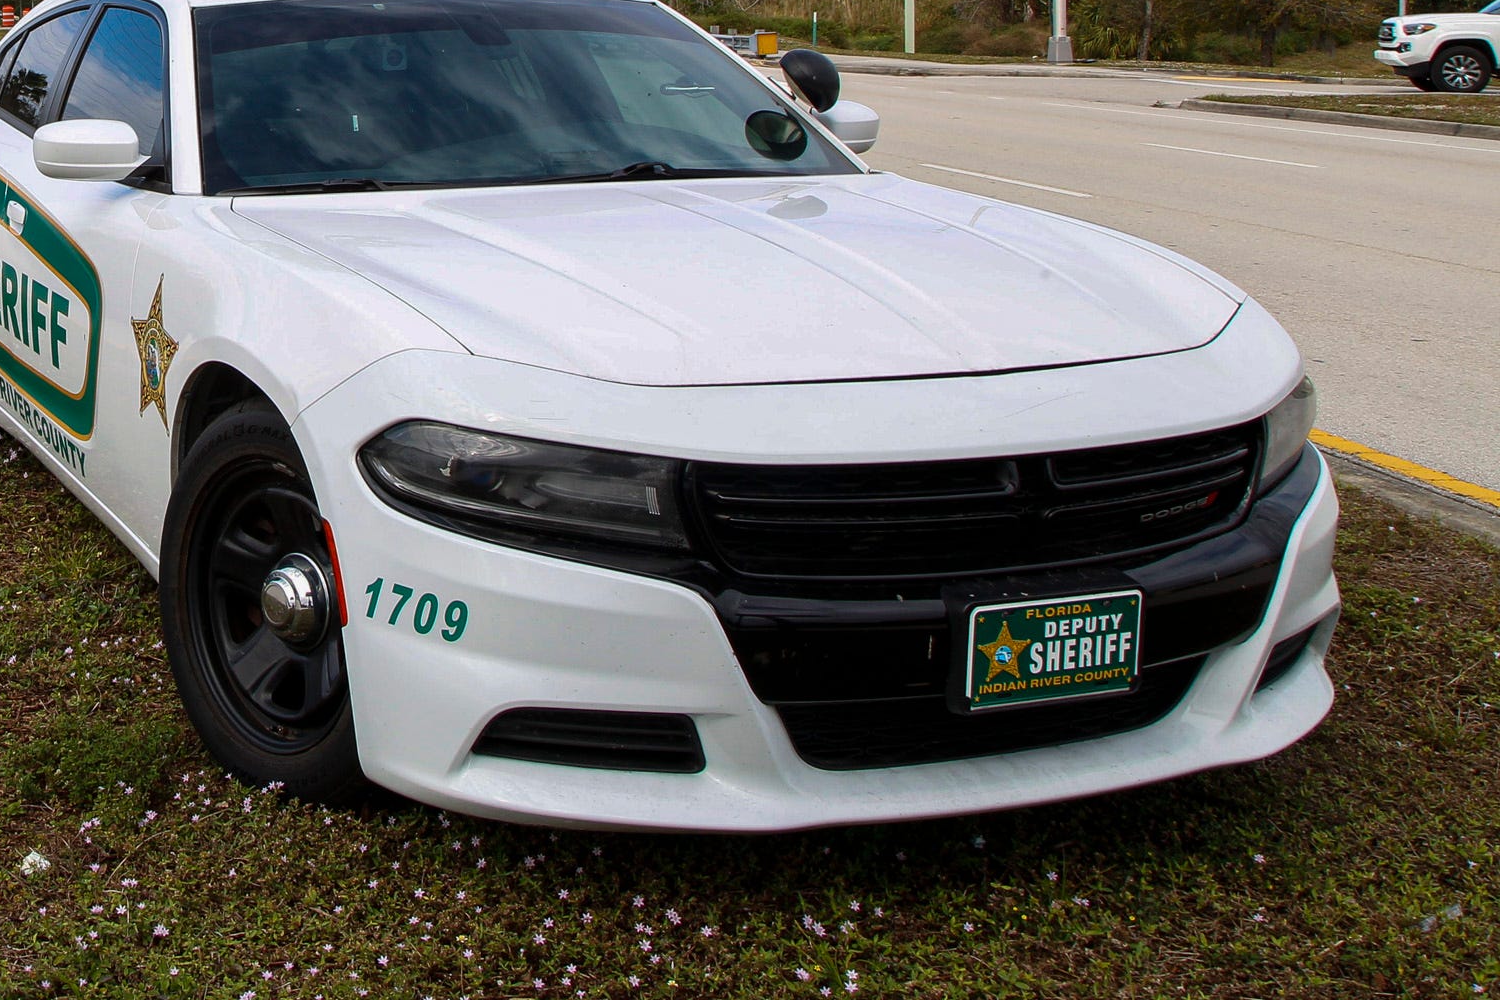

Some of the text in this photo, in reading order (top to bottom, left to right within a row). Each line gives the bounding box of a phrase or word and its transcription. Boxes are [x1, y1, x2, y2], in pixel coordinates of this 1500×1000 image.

[33, 409, 86, 478] COUNTY
[1139, 496, 1209, 523] DODGE
[364, 577, 469, 642] 1709
[1025, 603, 1092, 620] FLORIDA
[1044, 613, 1124, 638] DEPUTY
[1029, 631, 1132, 674] SHERIFF
[978, 667, 1130, 695] INDIAN RIVER COUNTY
